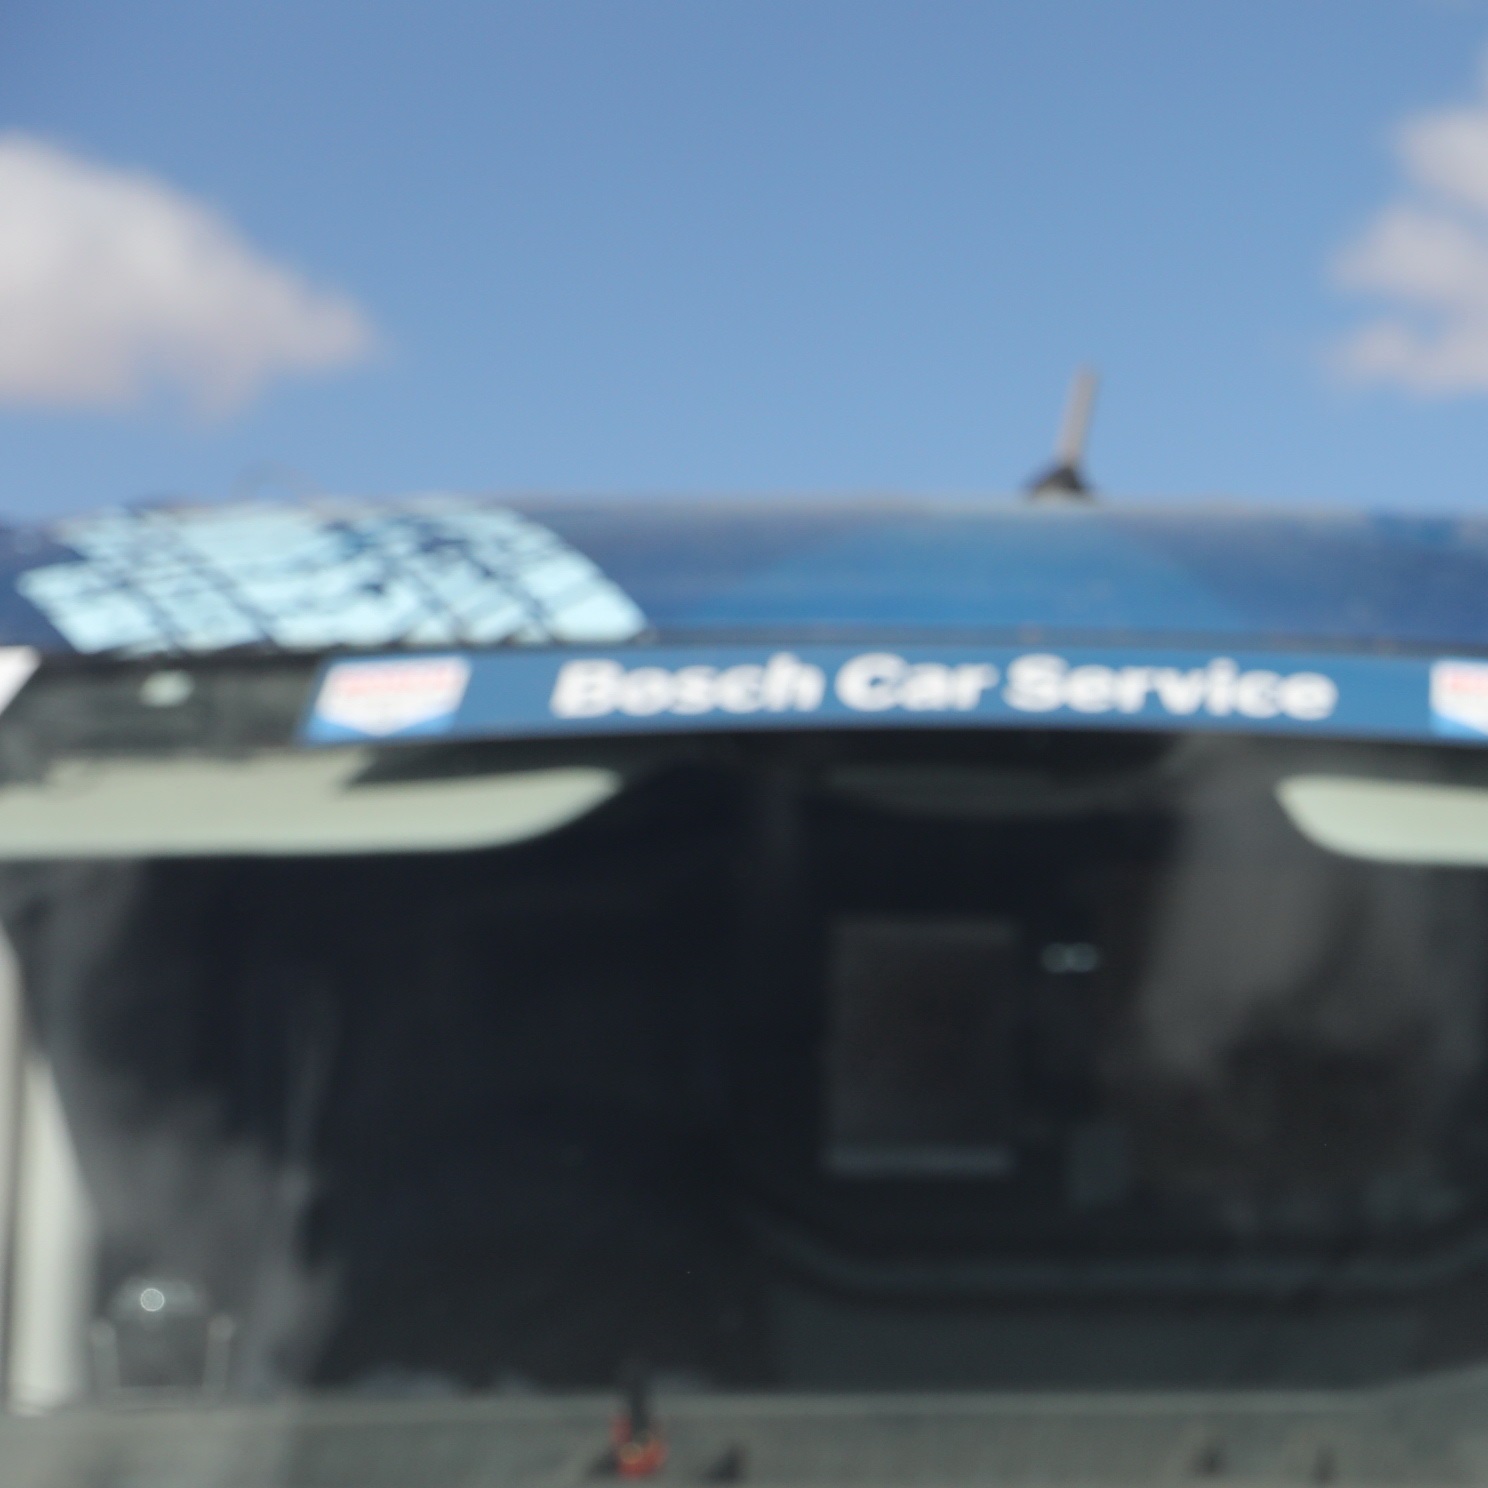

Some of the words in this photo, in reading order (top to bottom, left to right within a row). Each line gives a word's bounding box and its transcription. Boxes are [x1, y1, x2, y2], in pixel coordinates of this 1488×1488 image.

[551, 654, 826, 720] Bosch
[836, 654, 997, 714] Car
[1004, 654, 1337, 720] Service
